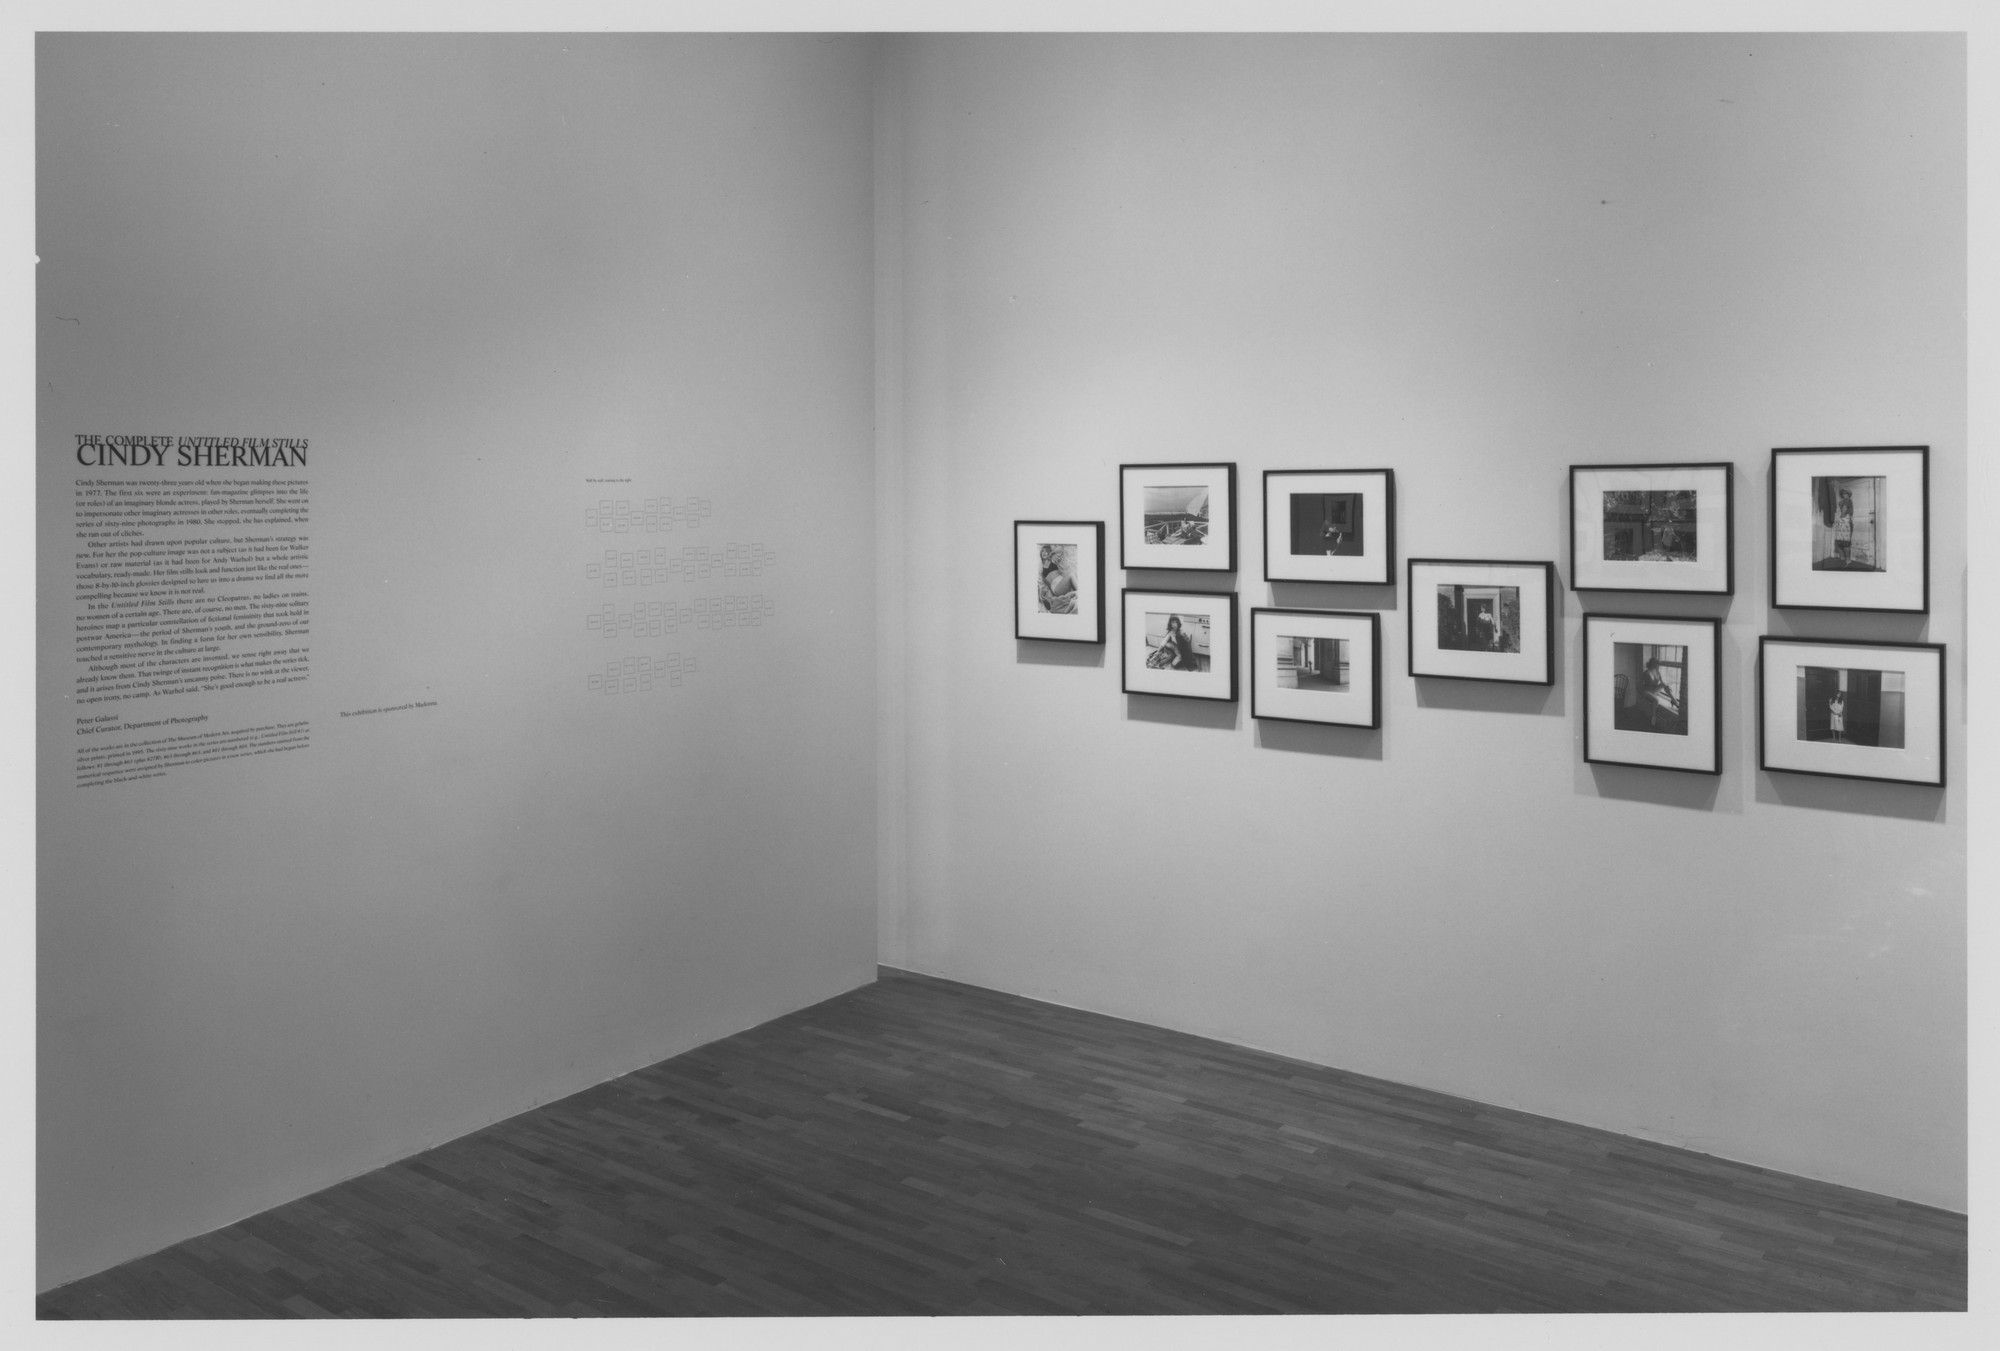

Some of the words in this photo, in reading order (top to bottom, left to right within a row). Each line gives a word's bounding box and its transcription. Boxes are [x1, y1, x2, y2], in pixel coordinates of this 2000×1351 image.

[75, 434, 102, 446] THE
[105, 435, 173, 446] COMPLETE
[178, 436, 239, 448] UNTITLED
[242, 437, 271, 448] FILM
[271, 438, 309, 449] STILLS
[77, 443, 170, 466] CINDY
[178, 445, 308, 467] SHERMAN
[75, 480, 95, 488] Cindy
[139, 480, 178, 488] twenty-three
[123, 500, 155, 508] imaginary
[83, 511, 123, 519] impersonate
[142, 510, 172, 518] imaginary
[104, 521, 136, 529] sixty-nine
[137, 519, 176, 528] photographs
[184, 538, 208, 547] popular
[129, 550, 166, 559] pop-culture
[95, 581, 135, 590] 8-by-10-inch
[135, 580, 160, 589] glossies
[161, 578, 189, 587] designed
[75, 593, 112, 602] compelling
[111, 601, 140, 609] Untitled
[127, 620, 158, 630] particular
[159, 618, 199, 626] constellation
[76, 635, 102, 644] postwar
[151, 629, 172, 638] period
[76, 644, 123, 653] contemporary
[76, 654, 103, 663] touched
[88, 663, 119, 672] Although
[158, 658, 190, 666] characters
[76, 675, 99, 684] already
[132, 681, 151, 689] Cindy
[86, 697, 103, 705] open
[162, 687, 185, 696] Warhol
[94, 715, 119, 723] Galassi
[76, 727, 95, 735] Chief
[123, 720, 162, 731] Department
[170, 715, 209, 725] Photography
